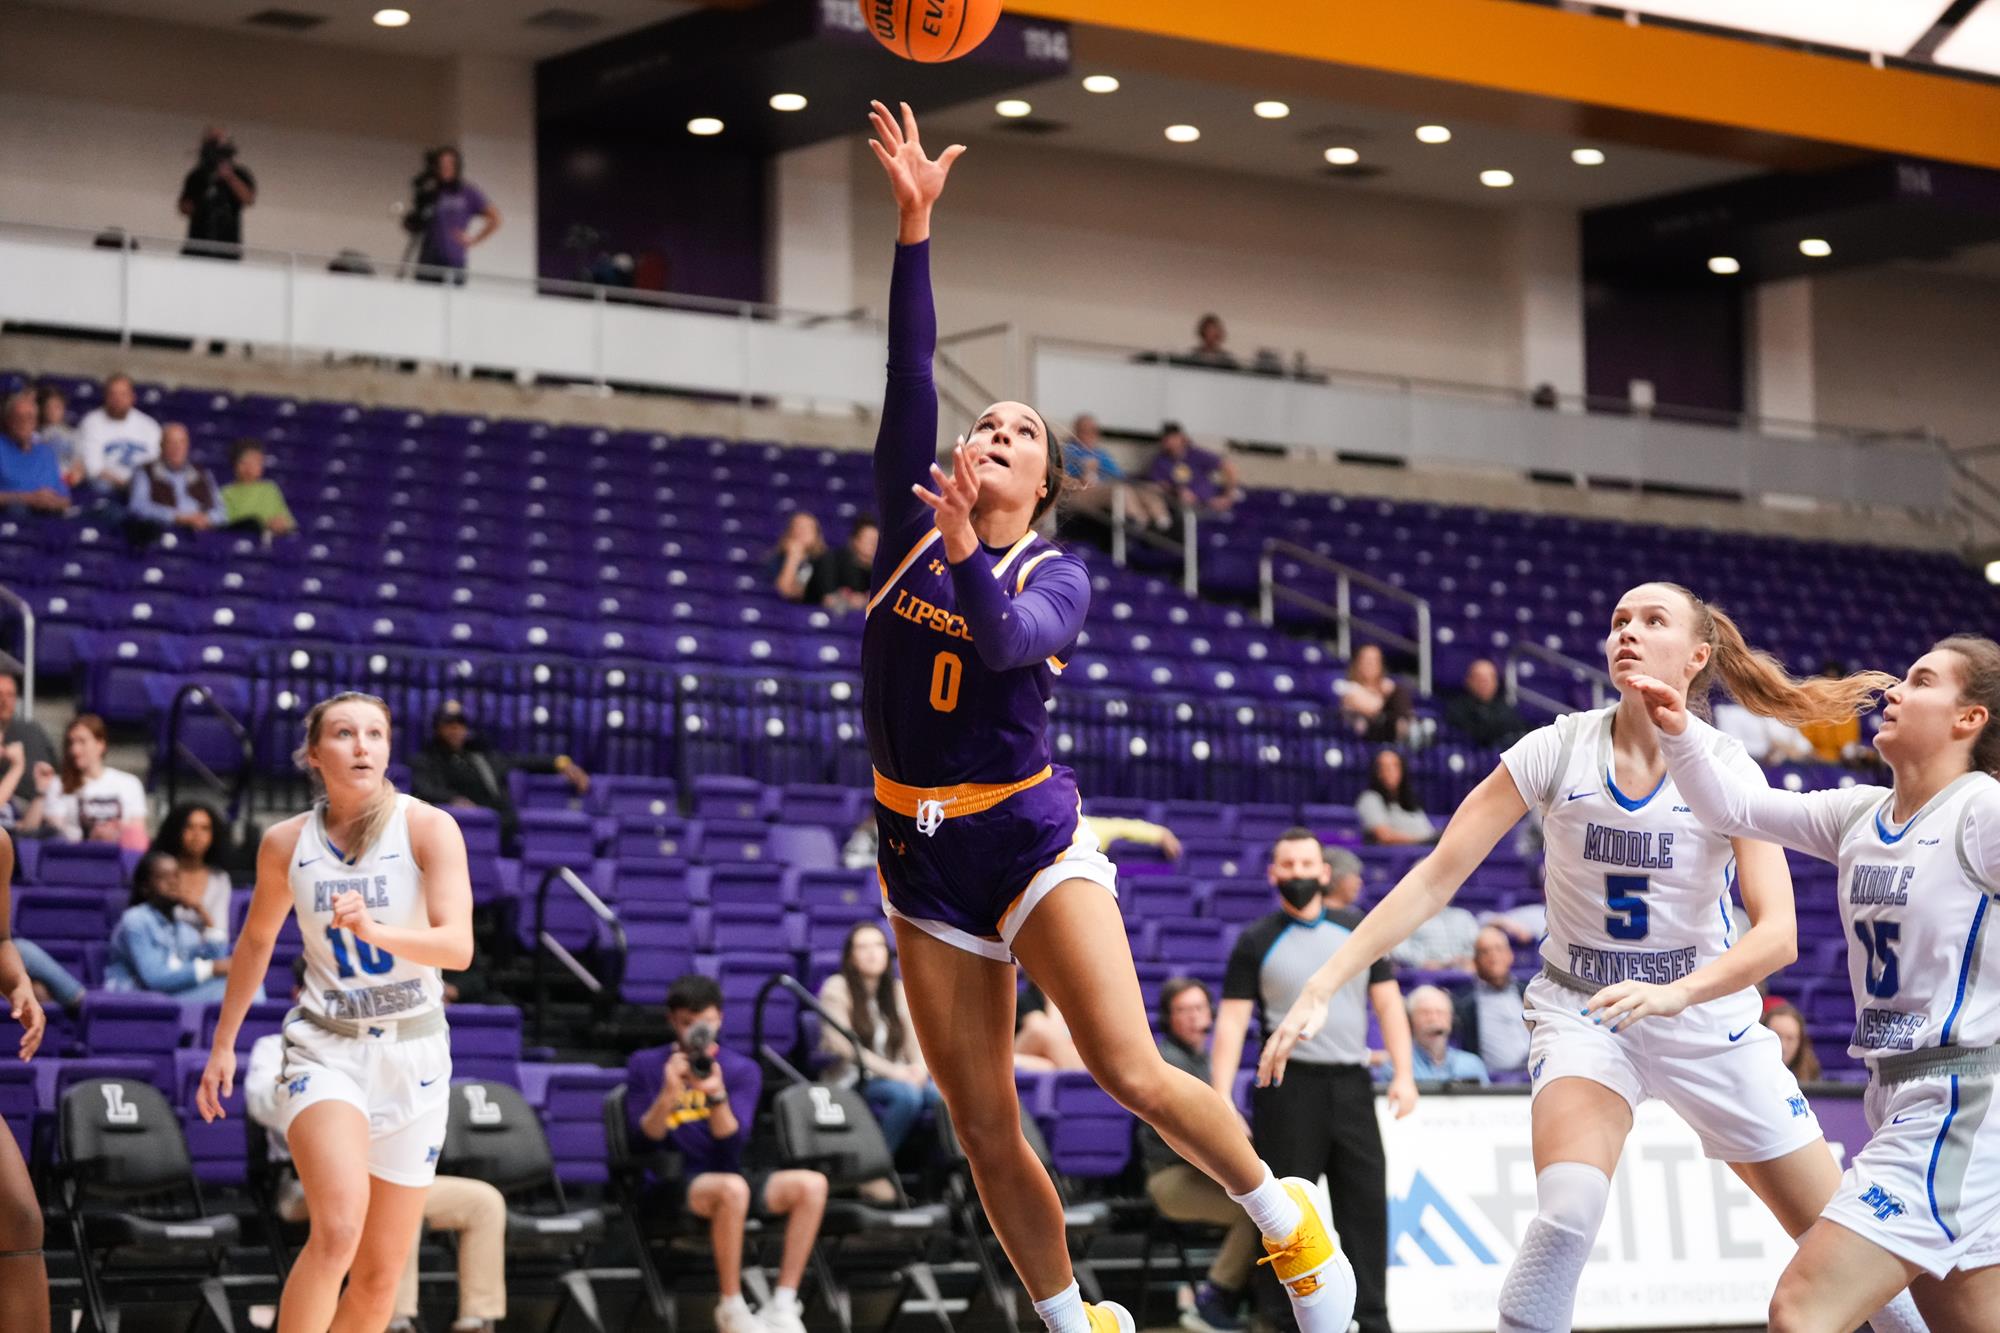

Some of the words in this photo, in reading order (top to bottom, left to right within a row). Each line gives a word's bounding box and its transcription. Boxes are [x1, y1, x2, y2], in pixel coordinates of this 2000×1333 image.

[892, 588, 974, 641] LIPSC
[930, 651, 963, 713] 0
[1584, 822, 1674, 869] MIDDLE
[1604, 872, 1651, 942] 5
[1850, 864, 1915, 906] MIDDLE
[1568, 944, 1697, 986] TENNESSEE
[1854, 919, 1901, 999] 15
[101, 1083, 138, 1124] L
[463, 1085, 502, 1124] L
[808, 1086, 846, 1125] L
